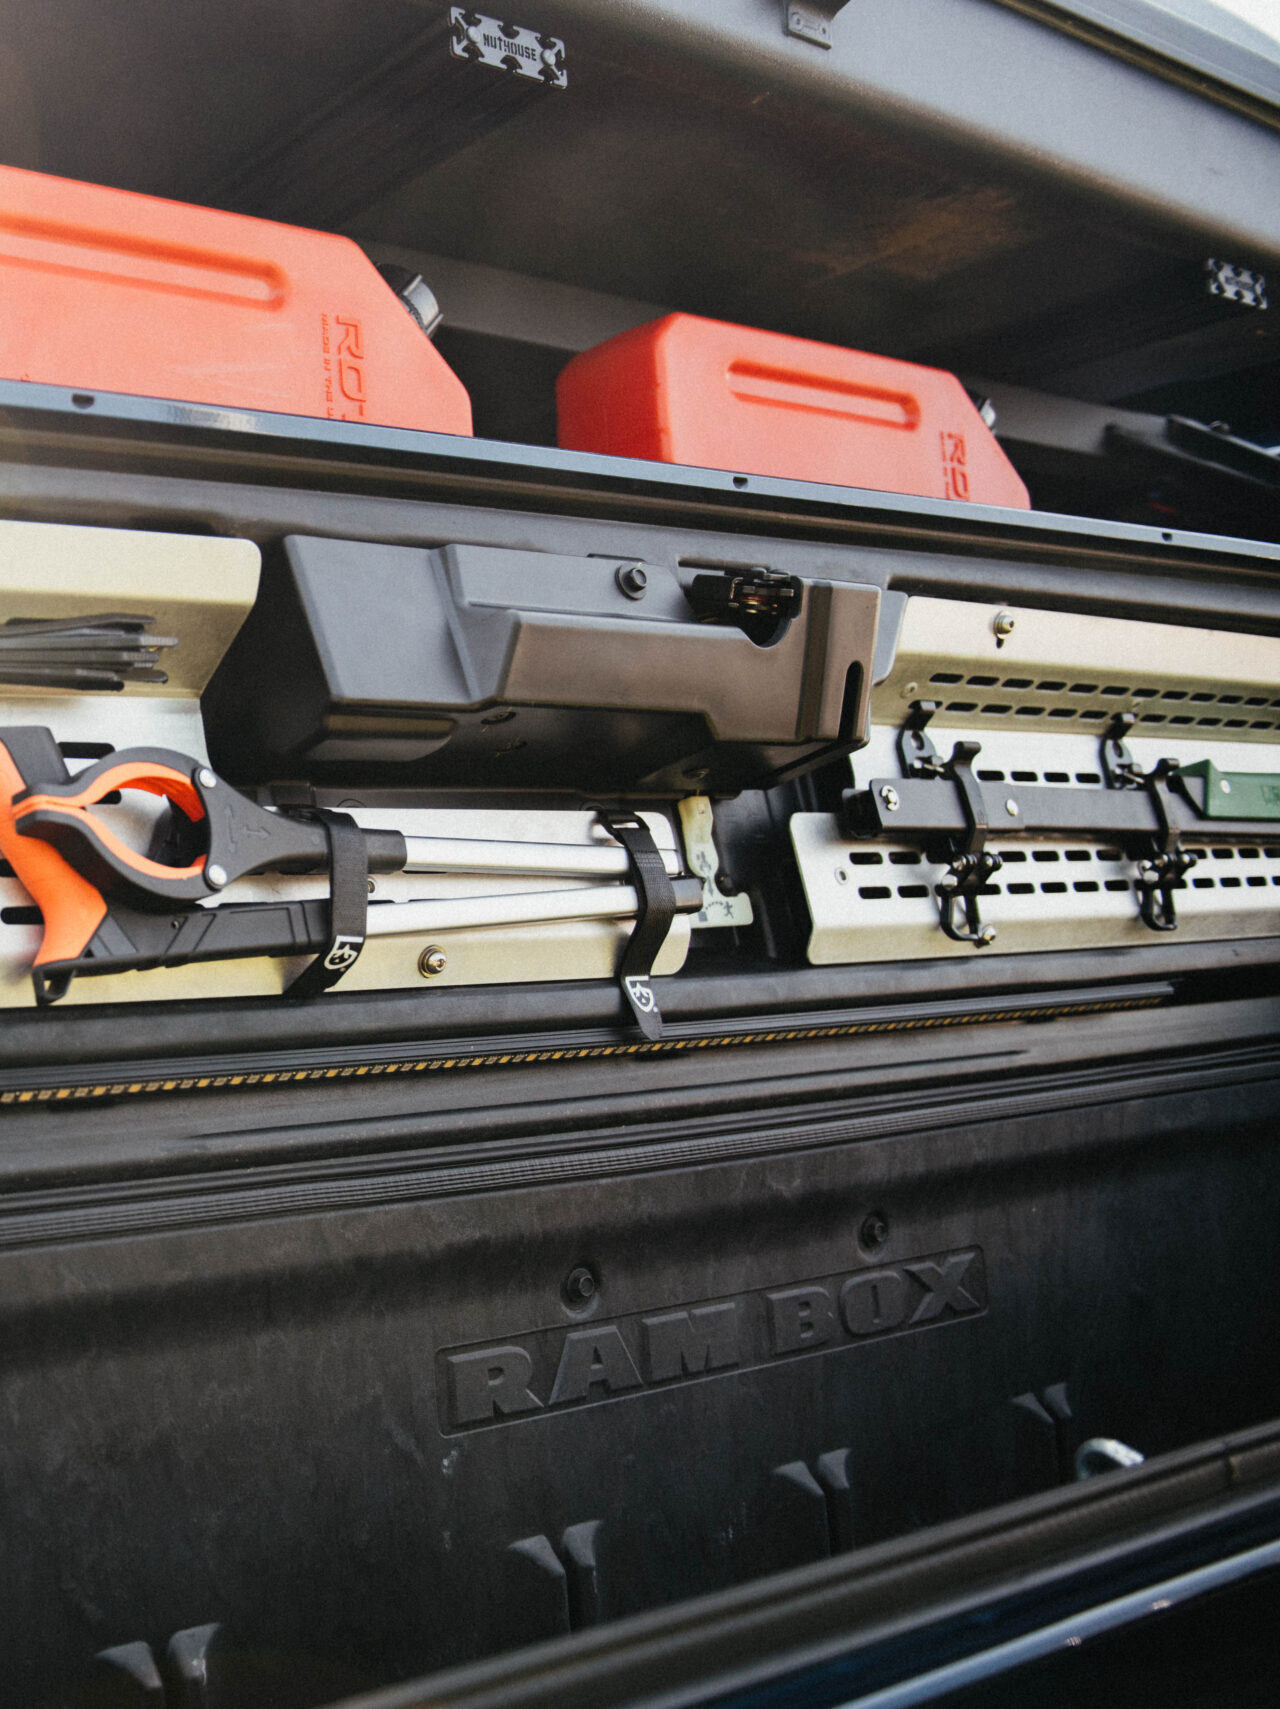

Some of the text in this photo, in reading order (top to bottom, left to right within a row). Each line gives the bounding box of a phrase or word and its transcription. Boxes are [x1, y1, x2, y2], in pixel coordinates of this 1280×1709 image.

[482, 33, 537, 62] NUTHOUSE
[447, 1251, 983, 1428] RAM BOX
